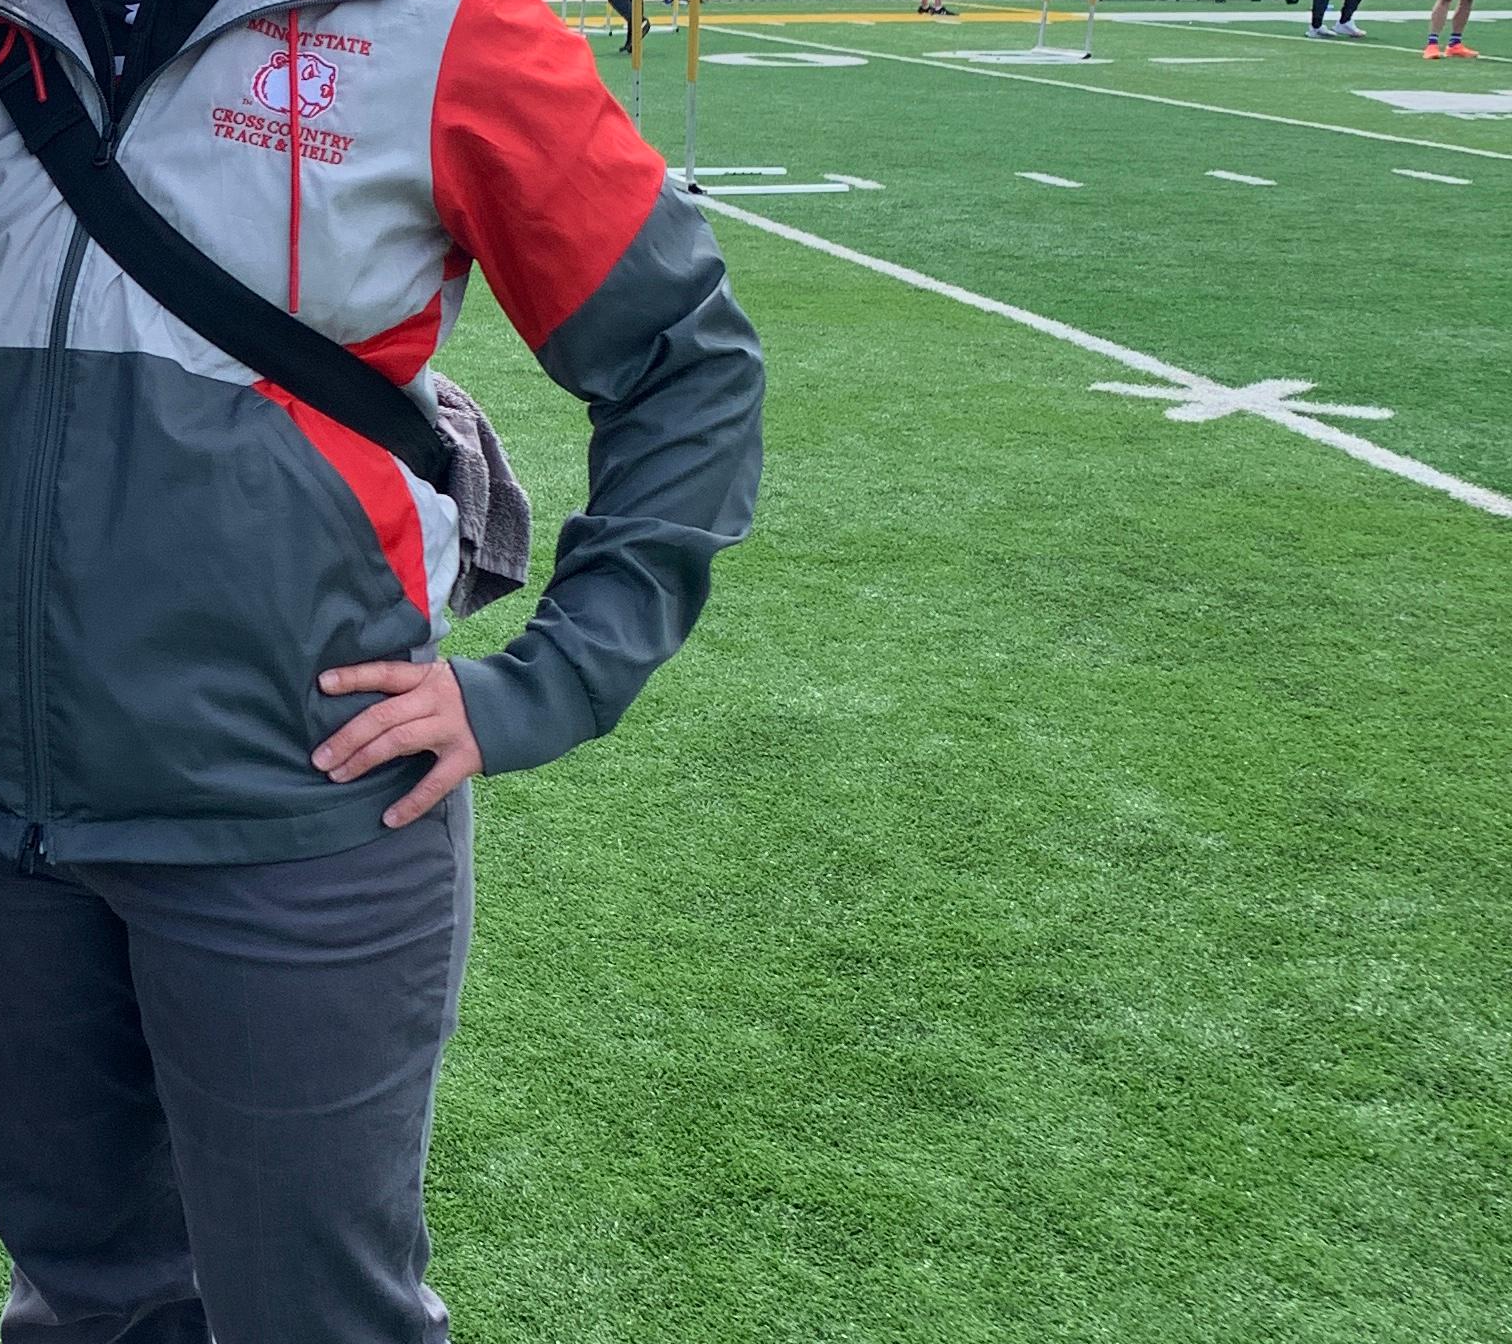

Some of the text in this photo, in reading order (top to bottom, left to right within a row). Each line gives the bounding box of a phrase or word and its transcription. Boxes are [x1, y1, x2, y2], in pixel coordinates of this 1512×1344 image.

[247, 17, 373, 56] MINT STATE
[212, 108, 265, 130] CROSS
[214, 124, 343, 165] TRACK & IELD
